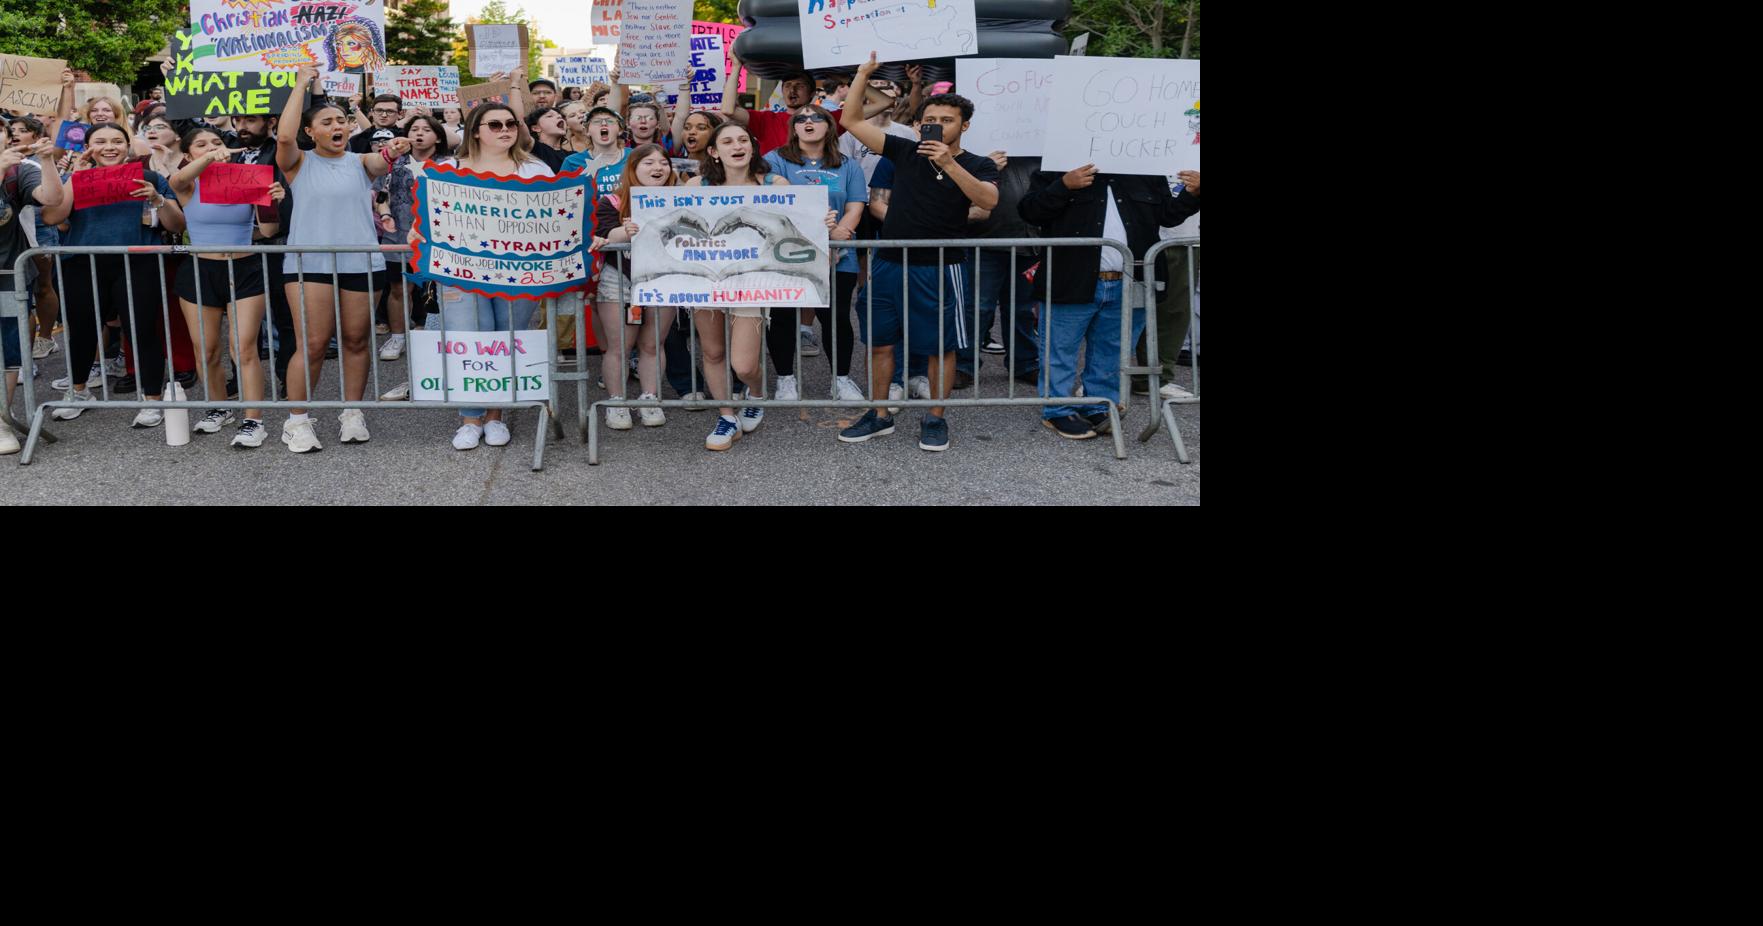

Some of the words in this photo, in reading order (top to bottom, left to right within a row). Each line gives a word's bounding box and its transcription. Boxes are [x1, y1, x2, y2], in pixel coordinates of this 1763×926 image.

[400, 68, 422, 76] SAY
[581, 64, 608, 73] RACIST
[165, 72, 243, 96] WHAT
[396, 76, 438, 88] THEIR
[1082, 69, 1138, 107] GO
[1149, 73, 1200, 103] HOME
[205, 89, 271, 115] ARE
[399, 87, 440, 100] NAMES
[1084, 111, 1167, 133] COUCH
[1089, 136, 1177, 158] FUCKER
[431, 181, 491, 202] NOTHING
[506, 192, 518, 206] IS
[526, 189, 574, 208] MORE
[709, 195, 745, 206] JUST
[753, 193, 796, 206] ABOUT
[453, 201, 553, 219] AMERICAN
[444, 211, 485, 231] THAN
[498, 220, 561, 234] OPPOSING
[459, 233, 468, 247] A
[490, 239, 562, 252] TYRANT
[433, 248, 445, 260] DO
[449, 253, 474, 267] YOUR
[495, 260, 553, 272] INVOKE
[559, 255, 577, 266] THE
[682, 247, 759, 262] ANYMORE
[453, 269, 477, 280] J.D.
[669, 291, 711, 304] ABOUT
[712, 287, 806, 304] HUMANITY
[437, 340, 468, 355] NO
[475, 338, 527, 357] WAR
[462, 360, 499, 372] FOR
[463, 375, 543, 393] PROFITS
